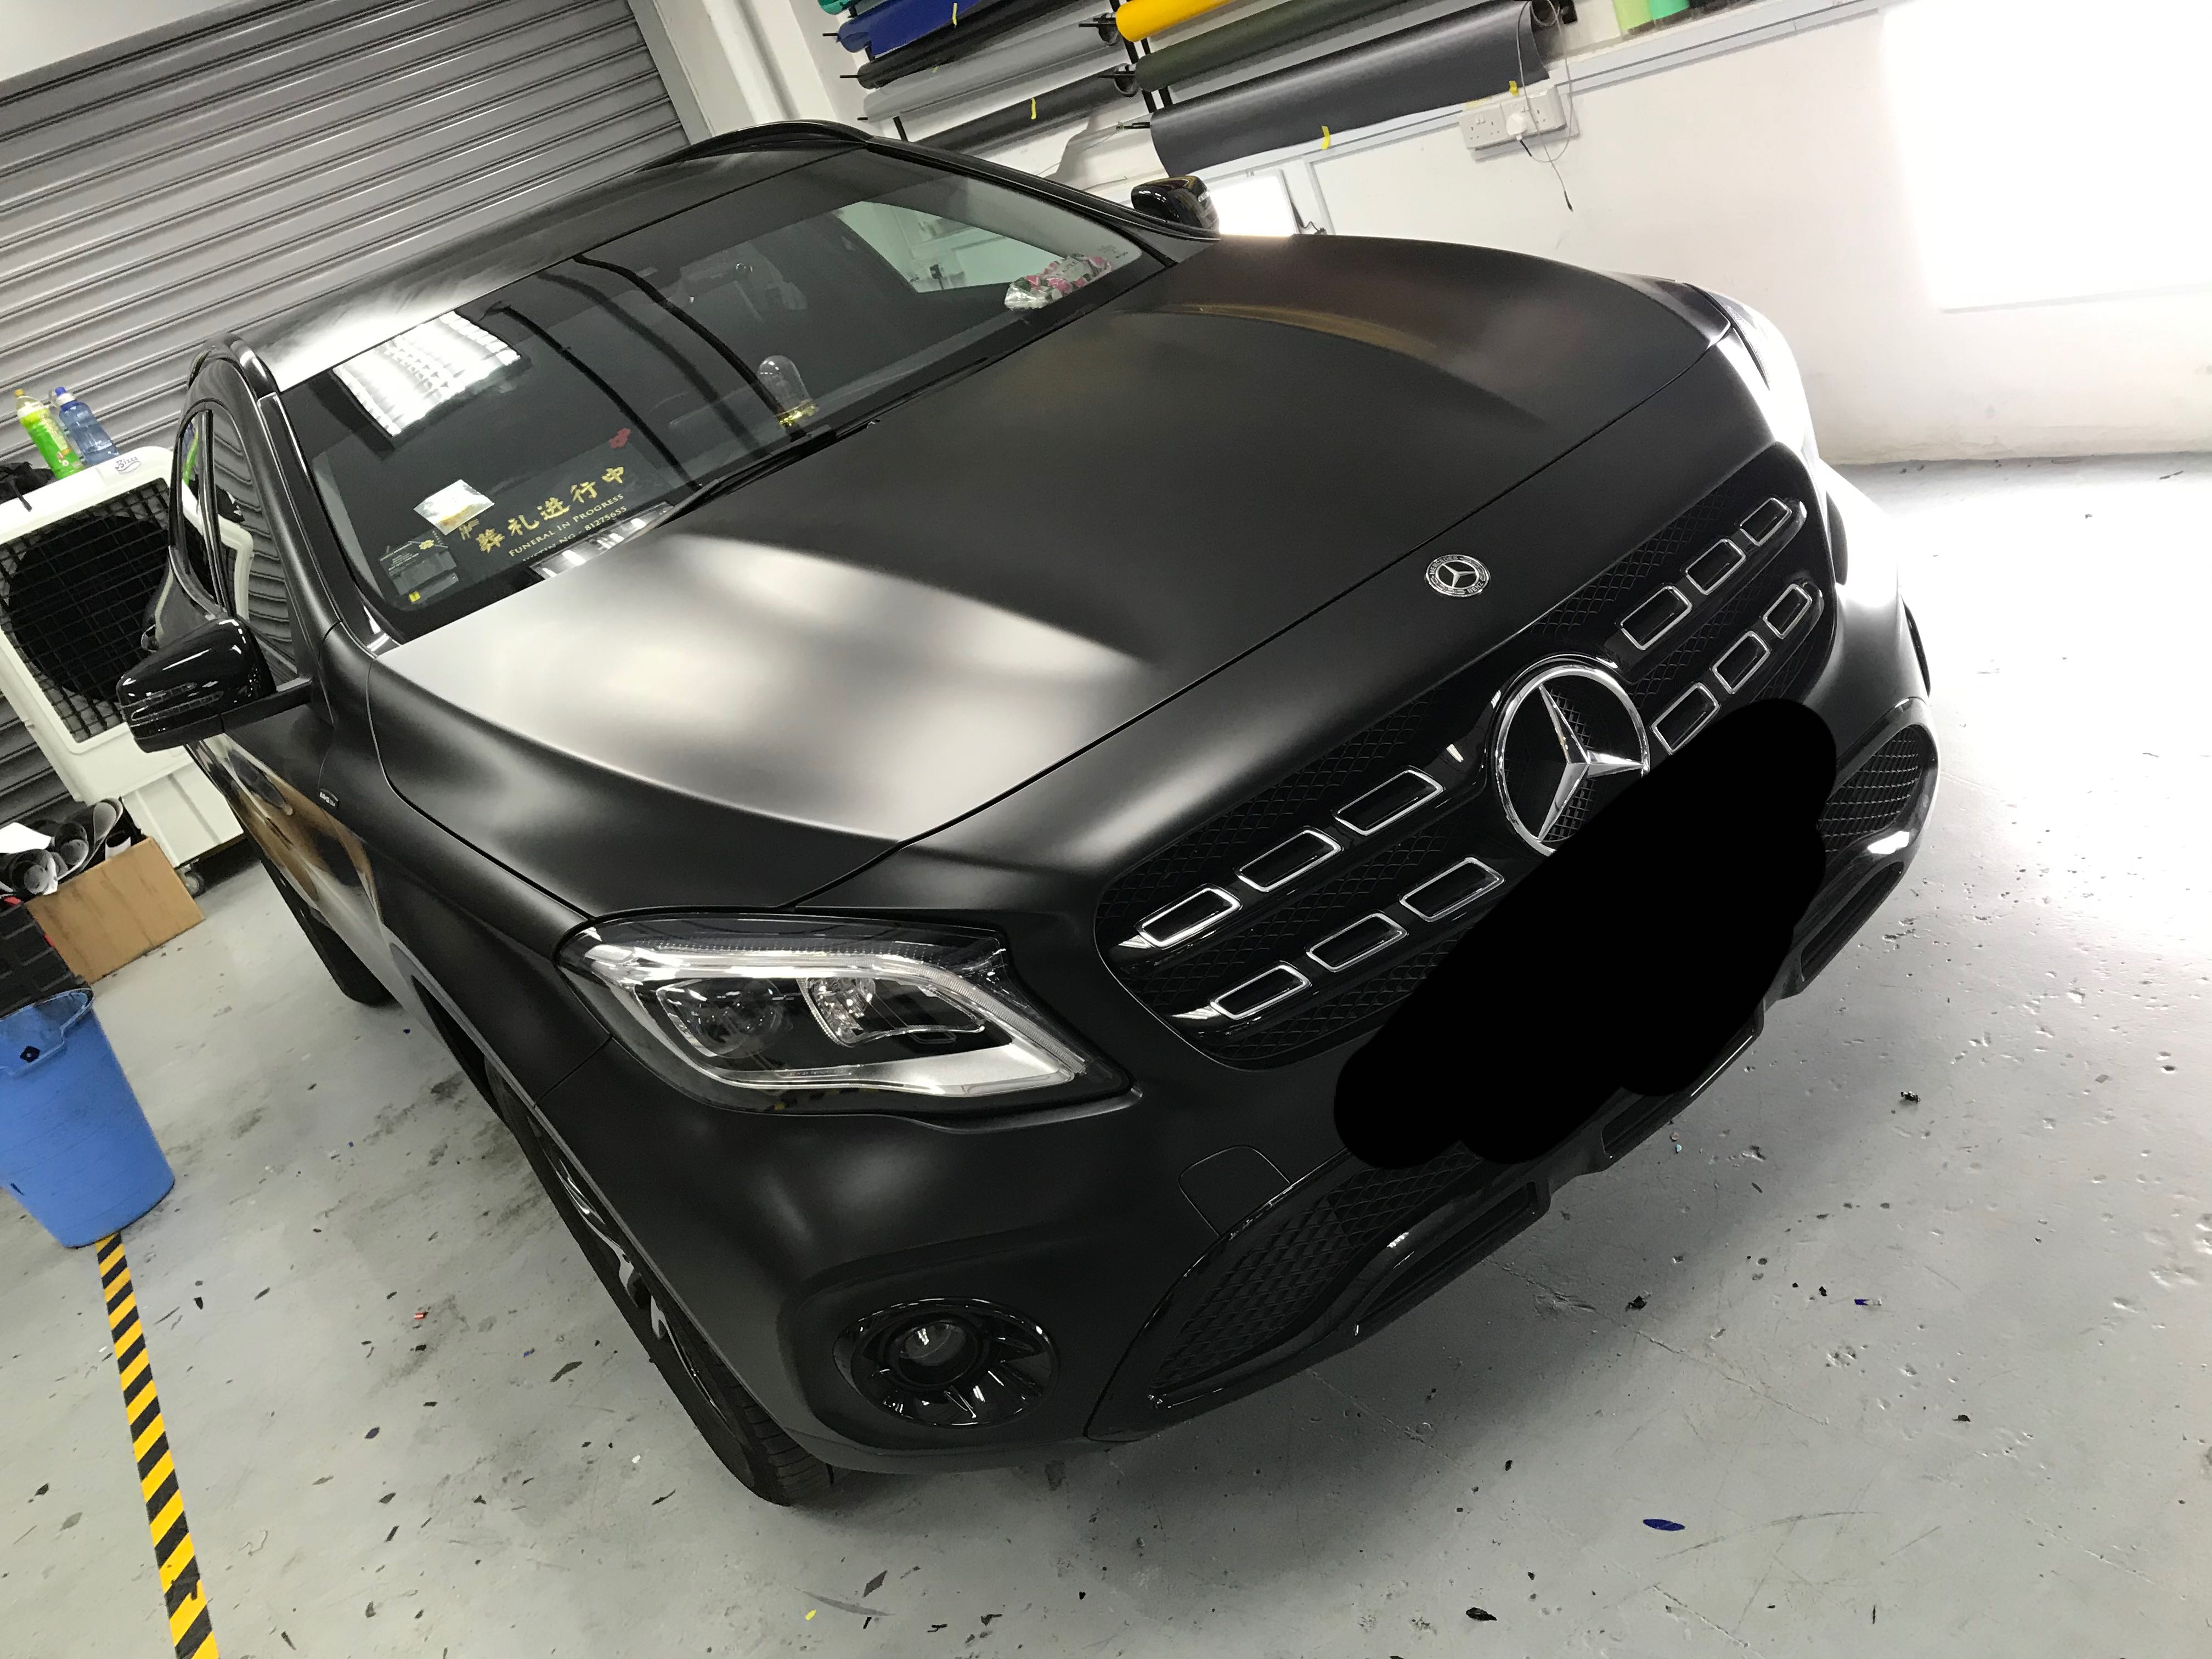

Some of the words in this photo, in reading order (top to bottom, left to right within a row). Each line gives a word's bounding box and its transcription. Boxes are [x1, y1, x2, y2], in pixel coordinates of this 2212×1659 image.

[508, 531, 555, 557] FUNERAL
[557, 521, 571, 531] IN
[573, 494, 624, 522] PROGRESS
[584, 506, 627, 531] 81275655
[1429, 556, 1458, 575] MERCEDES
[1467, 582, 1484, 594] BENZ
